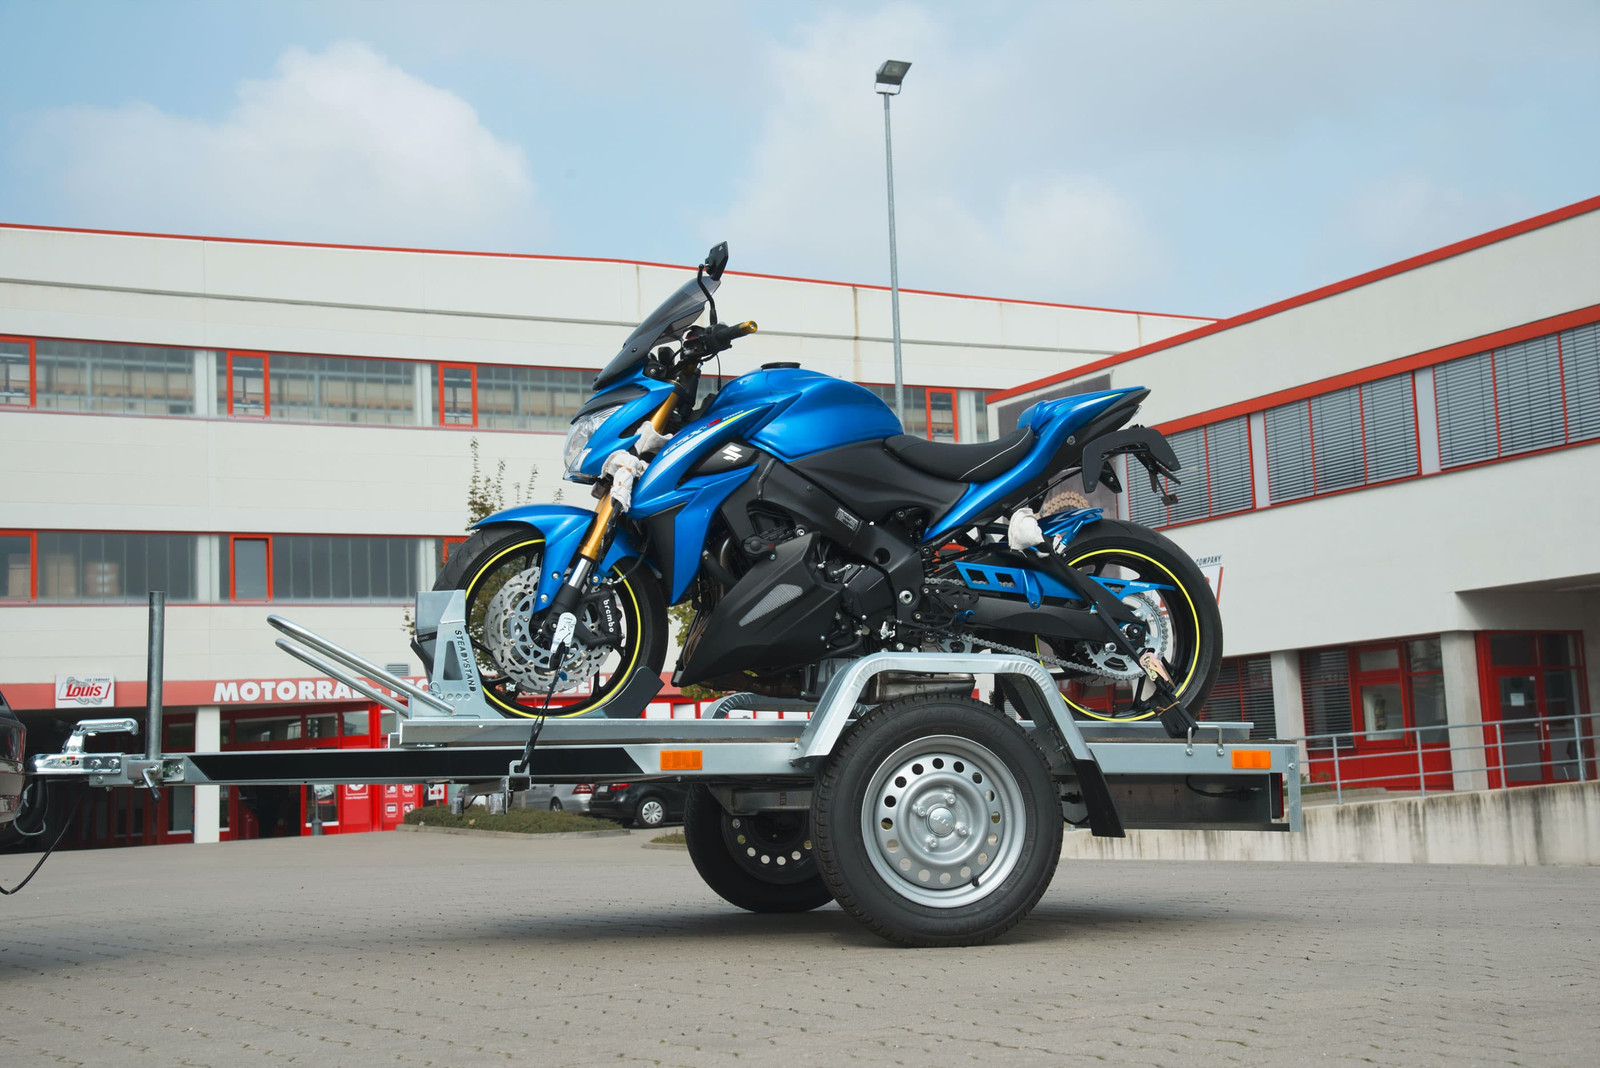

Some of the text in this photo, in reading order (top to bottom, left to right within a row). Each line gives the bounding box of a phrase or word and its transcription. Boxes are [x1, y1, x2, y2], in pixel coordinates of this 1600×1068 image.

[1196, 555, 1222, 566] COMPANY
[603, 599, 615, 633] brembo
[454, 630, 477, 692] STEADYSTAND
[66, 683, 102, 697] Louis
